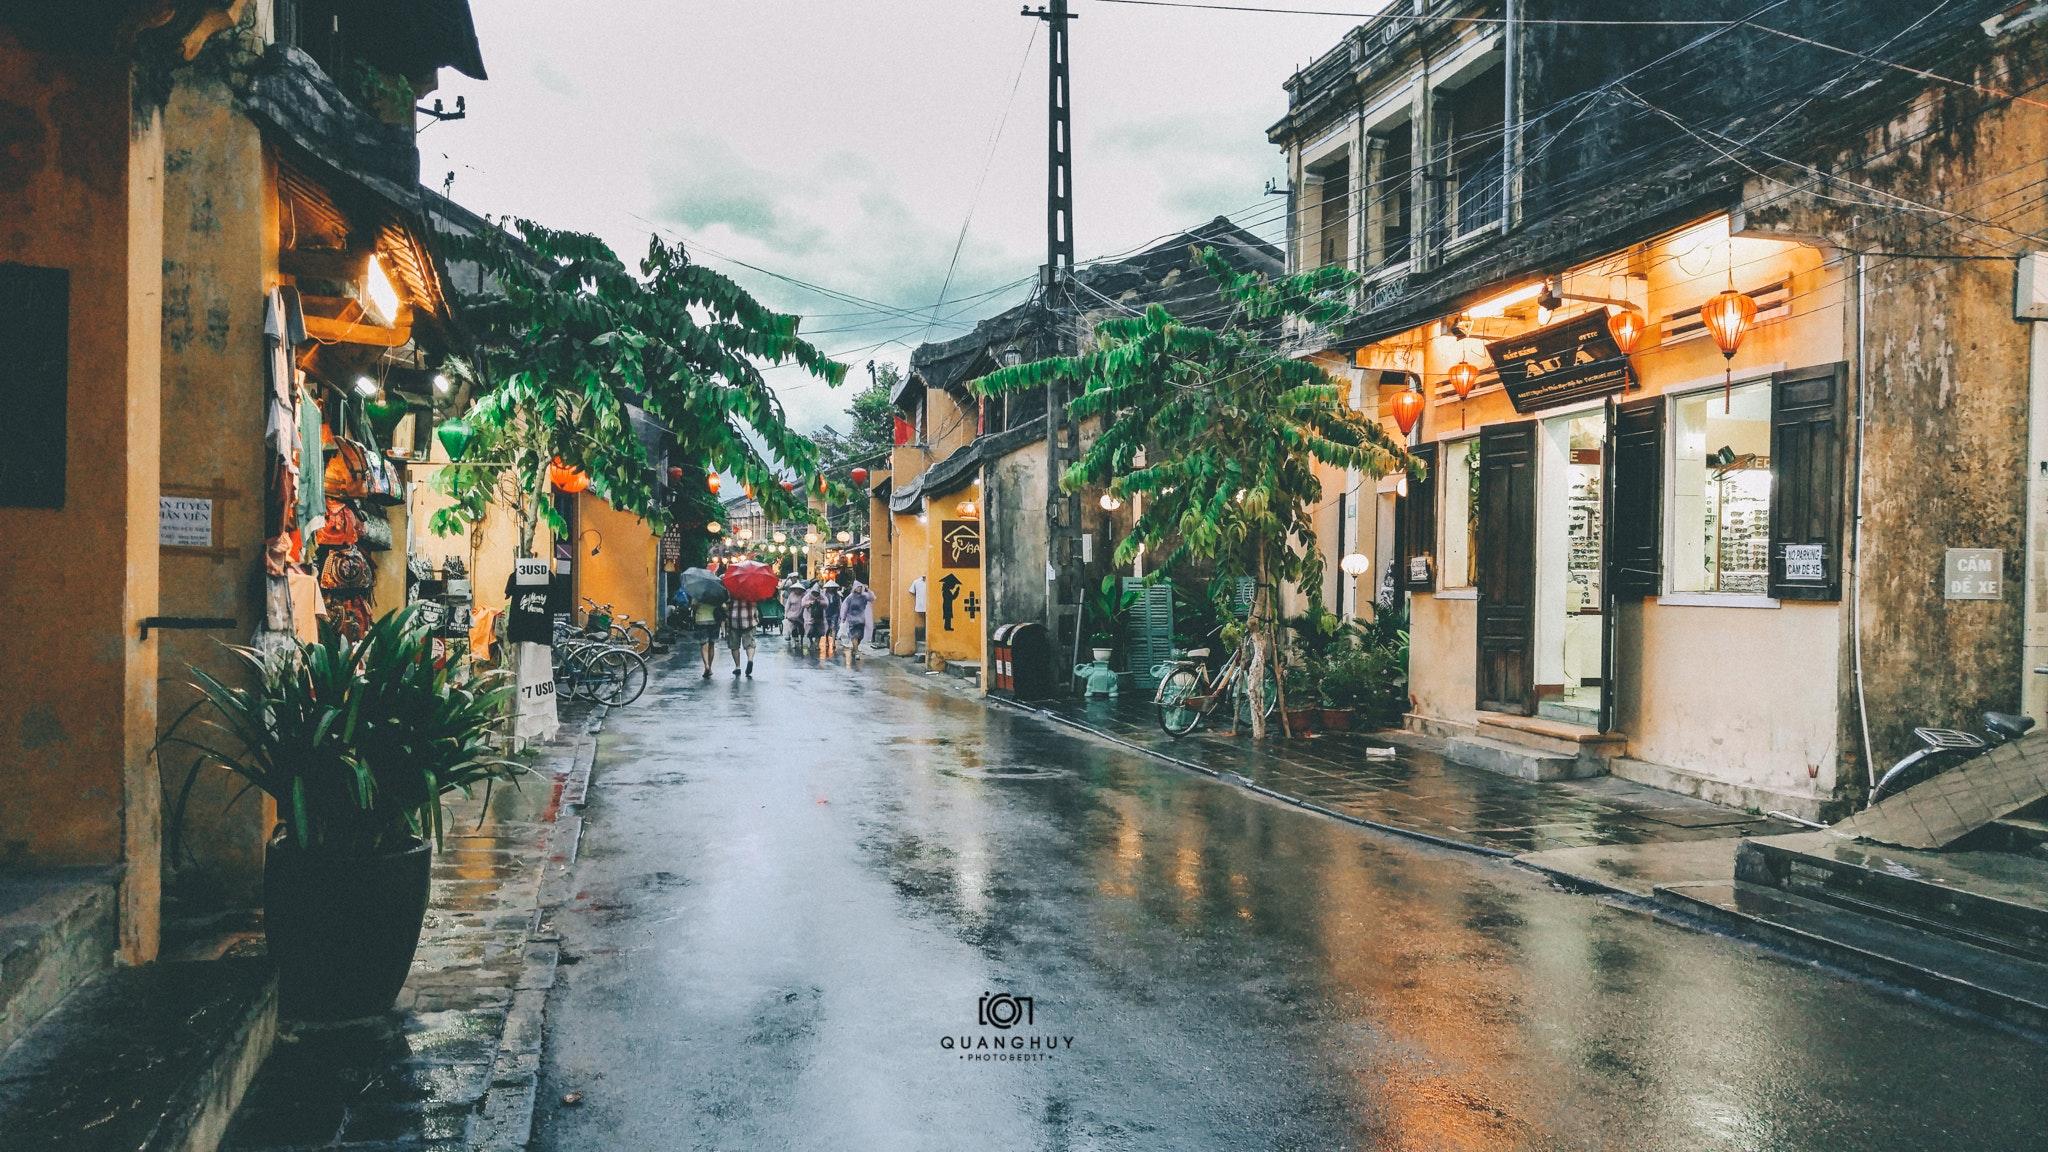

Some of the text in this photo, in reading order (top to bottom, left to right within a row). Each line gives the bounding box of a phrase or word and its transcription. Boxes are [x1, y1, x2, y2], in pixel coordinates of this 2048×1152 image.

[1525, 356, 1561, 378] ÂU
[1573, 344, 1596, 366] Á
[518, 564, 548, 576] 3USD
[1978, 581, 1997, 593] XE
[535, 681, 554, 696] USD
